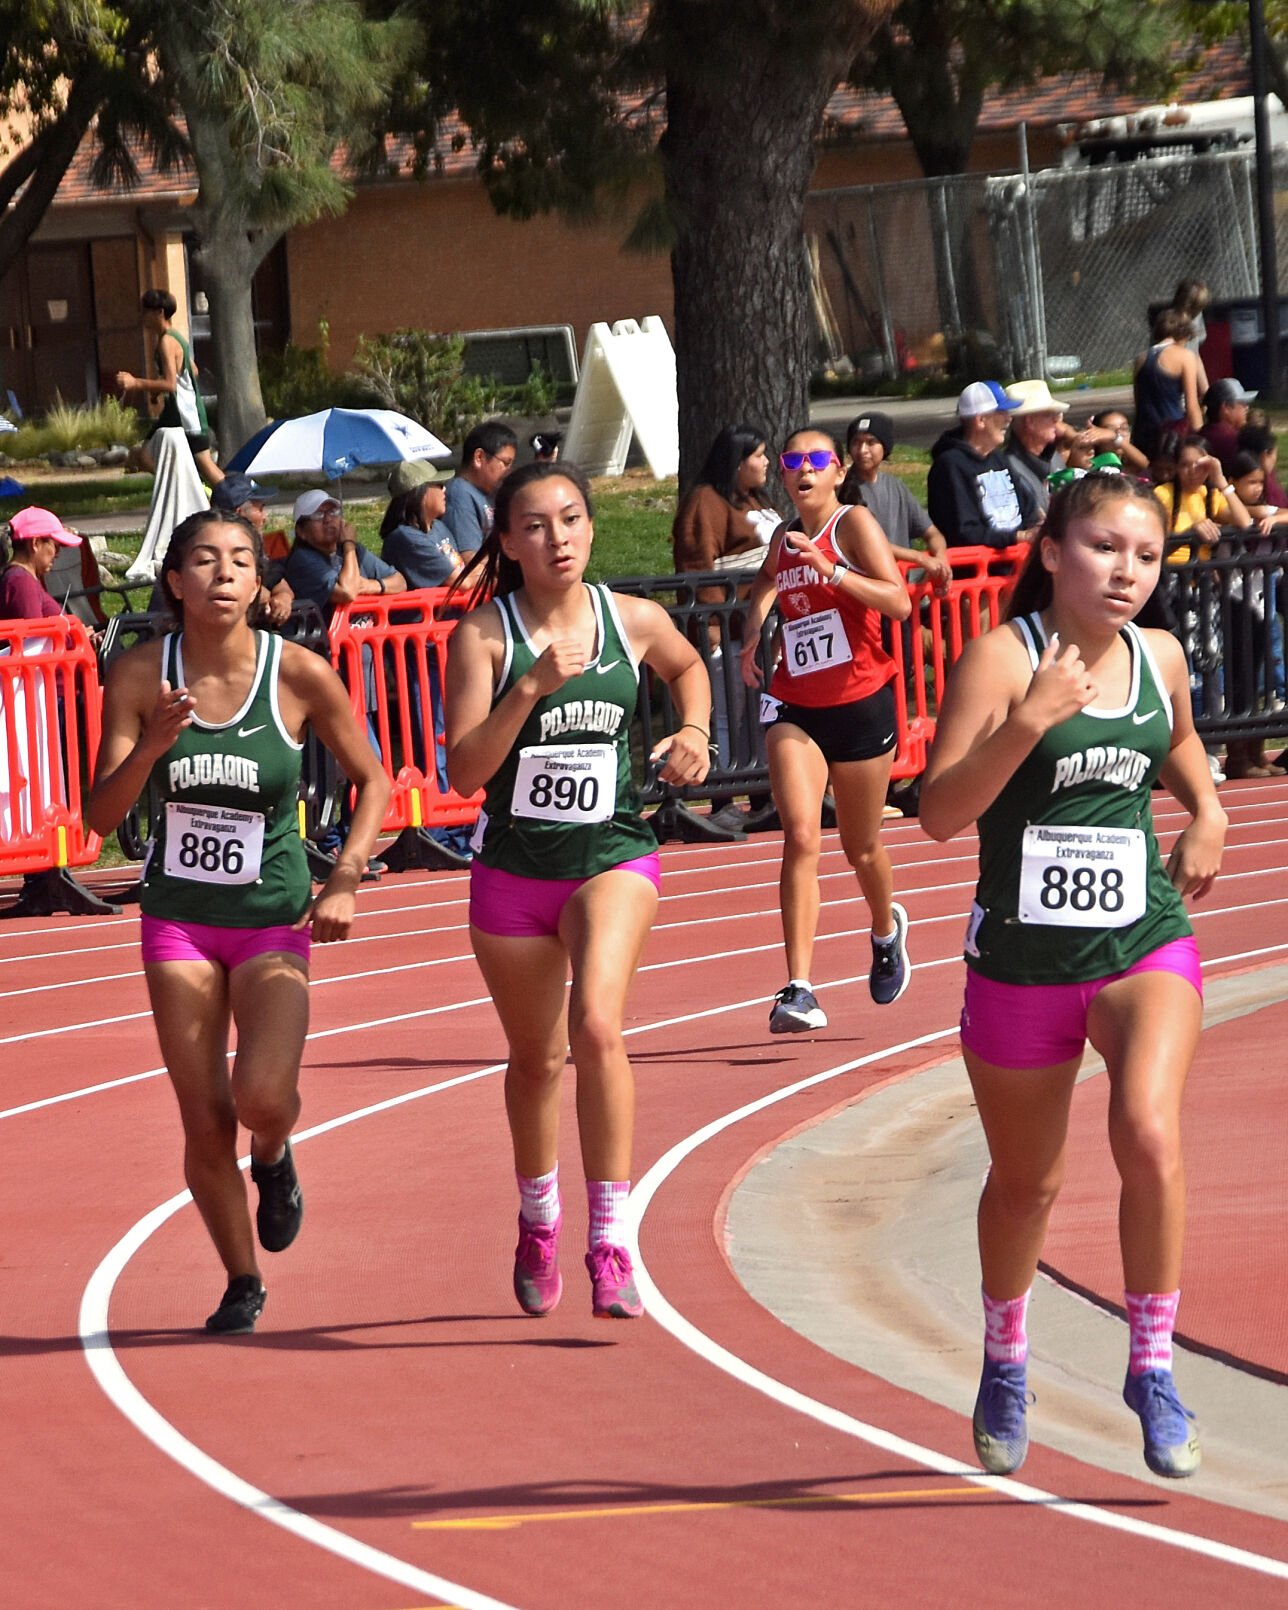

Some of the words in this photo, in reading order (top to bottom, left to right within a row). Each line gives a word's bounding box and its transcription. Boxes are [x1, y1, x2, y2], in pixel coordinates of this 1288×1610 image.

[776, 565, 829, 592] CADEM
[794, 632, 834, 667] 617
[540, 700, 625, 743] POJOAQUE
[168, 753, 260, 793] POJOAQUE
[544, 760, 592, 773] Extravaganza
[529, 774, 599, 812] 890
[176, 804, 219, 820] Albuquerque
[220, 809, 254, 824] Academy
[191, 818, 237, 834] Extravaganza
[179, 832, 245, 875] 886
[1036, 829, 1093, 845] Albuquerque
[1096, 832, 1131, 848] Academy
[1056, 846, 1115, 861] Extravaganza
[1040, 865, 1124, 913] 888
